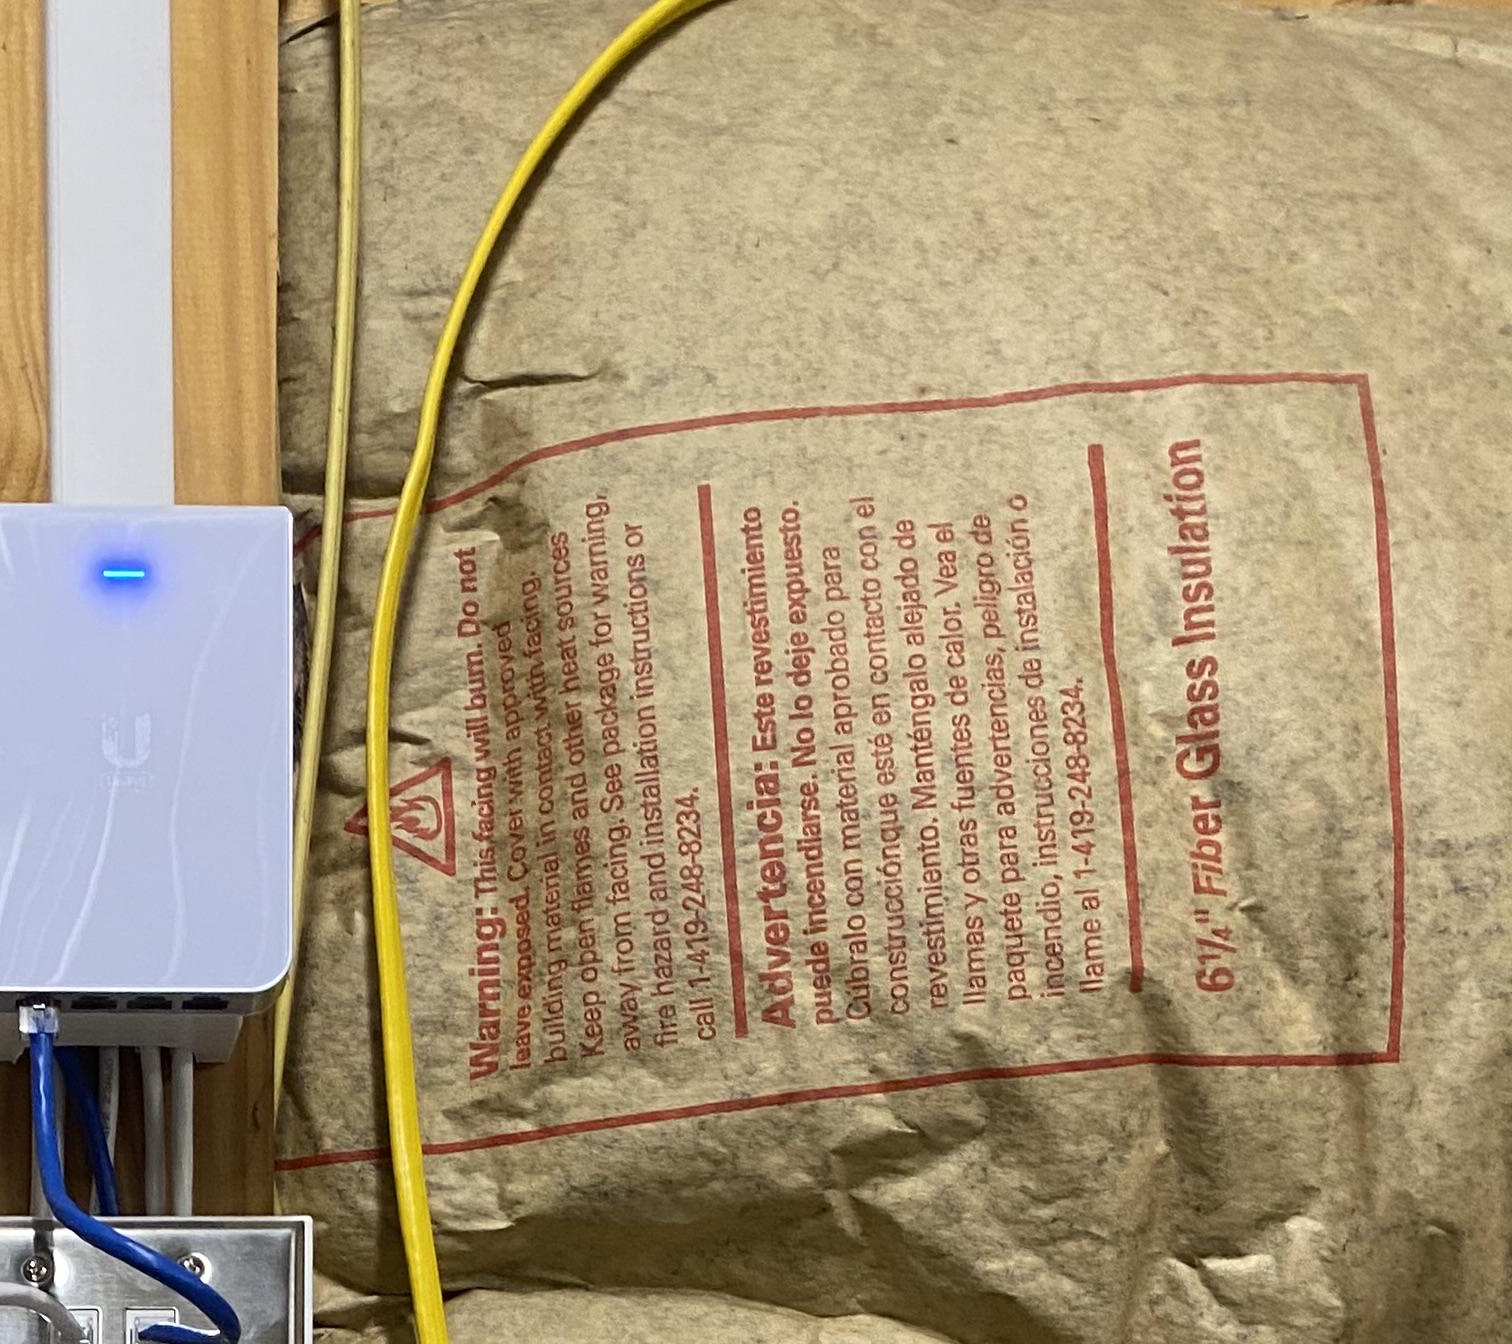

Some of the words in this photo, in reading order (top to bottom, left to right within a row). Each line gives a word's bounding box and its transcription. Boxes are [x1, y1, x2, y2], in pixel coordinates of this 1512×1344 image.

[626, 525, 641, 547] or
[857, 497, 874, 518] el
[892, 519, 915, 549] de
[928, 524, 954, 543] el
[972, 514, 992, 545] de
[1009, 494, 1027, 512] o
[585, 496, 610, 606] warning,
[780, 500, 809, 625] expuesto.
[824, 547, 848, 601] para
[860, 526, 878, 571] con
[936, 549, 957, 595] Vea
[1163, 438, 1216, 647] Insulation
[741, 507, 774, 686] revestimiento
[898, 557, 926, 645] alejado
[977, 553, 1003, 639] peligro
[1011, 519, 1037, 650] instalación
[591, 615, 611, 647] for
[628, 555, 652, 697] instructions
[785, 632, 814, 687] deje
[861, 578, 887, 684] contacto
[940, 601, 964, 668] calor.
[597, 654, 622, 757] package
[789, 694, 813, 721] lo
[824, 611, 856, 734] aprobado
[872, 694, 891, 725] en
[947, 675, 968, 706] de
[1022, 660, 1042, 688] de
[751, 692, 777, 752] Este
[791, 726, 817, 767] No
[904, 653, 936, 810] Manténgalo
[986, 646, 1015, 815] advertencias,
[1175, 655, 1222, 781] Glass
[600, 764, 624, 812] See
[635, 706, 662, 845] installation
[835, 745, 859, 849] material
[872, 734, 896, 785] esté
[951, 715, 974, 812] fuentes
[1028, 697, 1056, 864] instrucciones
[1060, 678, 1094, 879] 1-419-248-8234.
[606, 818, 631, 905] facing.
[641, 852, 667, 900] and
[797, 773, 827, 934] incendiarse.
[843, 860, 864, 907] con
[960, 820, 979, 884] otras
[998, 826, 1022, 884] para
[1189, 795, 1227, 896] Fiber
[675, 788, 710, 987] 1-419-248-8234.
[745, 761, 796, 1030] Advertencia:
[918, 817, 947, 1008] revestimiento.
[966, 894, 985, 908] y
[1077, 890, 1101, 910] al
[612, 912, 634, 974] from
[648, 910, 672, 995] hazard
[842, 914, 872, 1020] Cúbralo
[965, 916, 986, 1004] llamas
[1000, 892, 1031, 1002] paquete
[1037, 875, 1064, 996] incendio,
[1080, 920, 1104, 992] llame
[621, 984, 640, 1050] away
[690, 998, 715, 1040] call
[805, 940, 838, 1024] puede
[655, 1005, 676, 1047] fire
